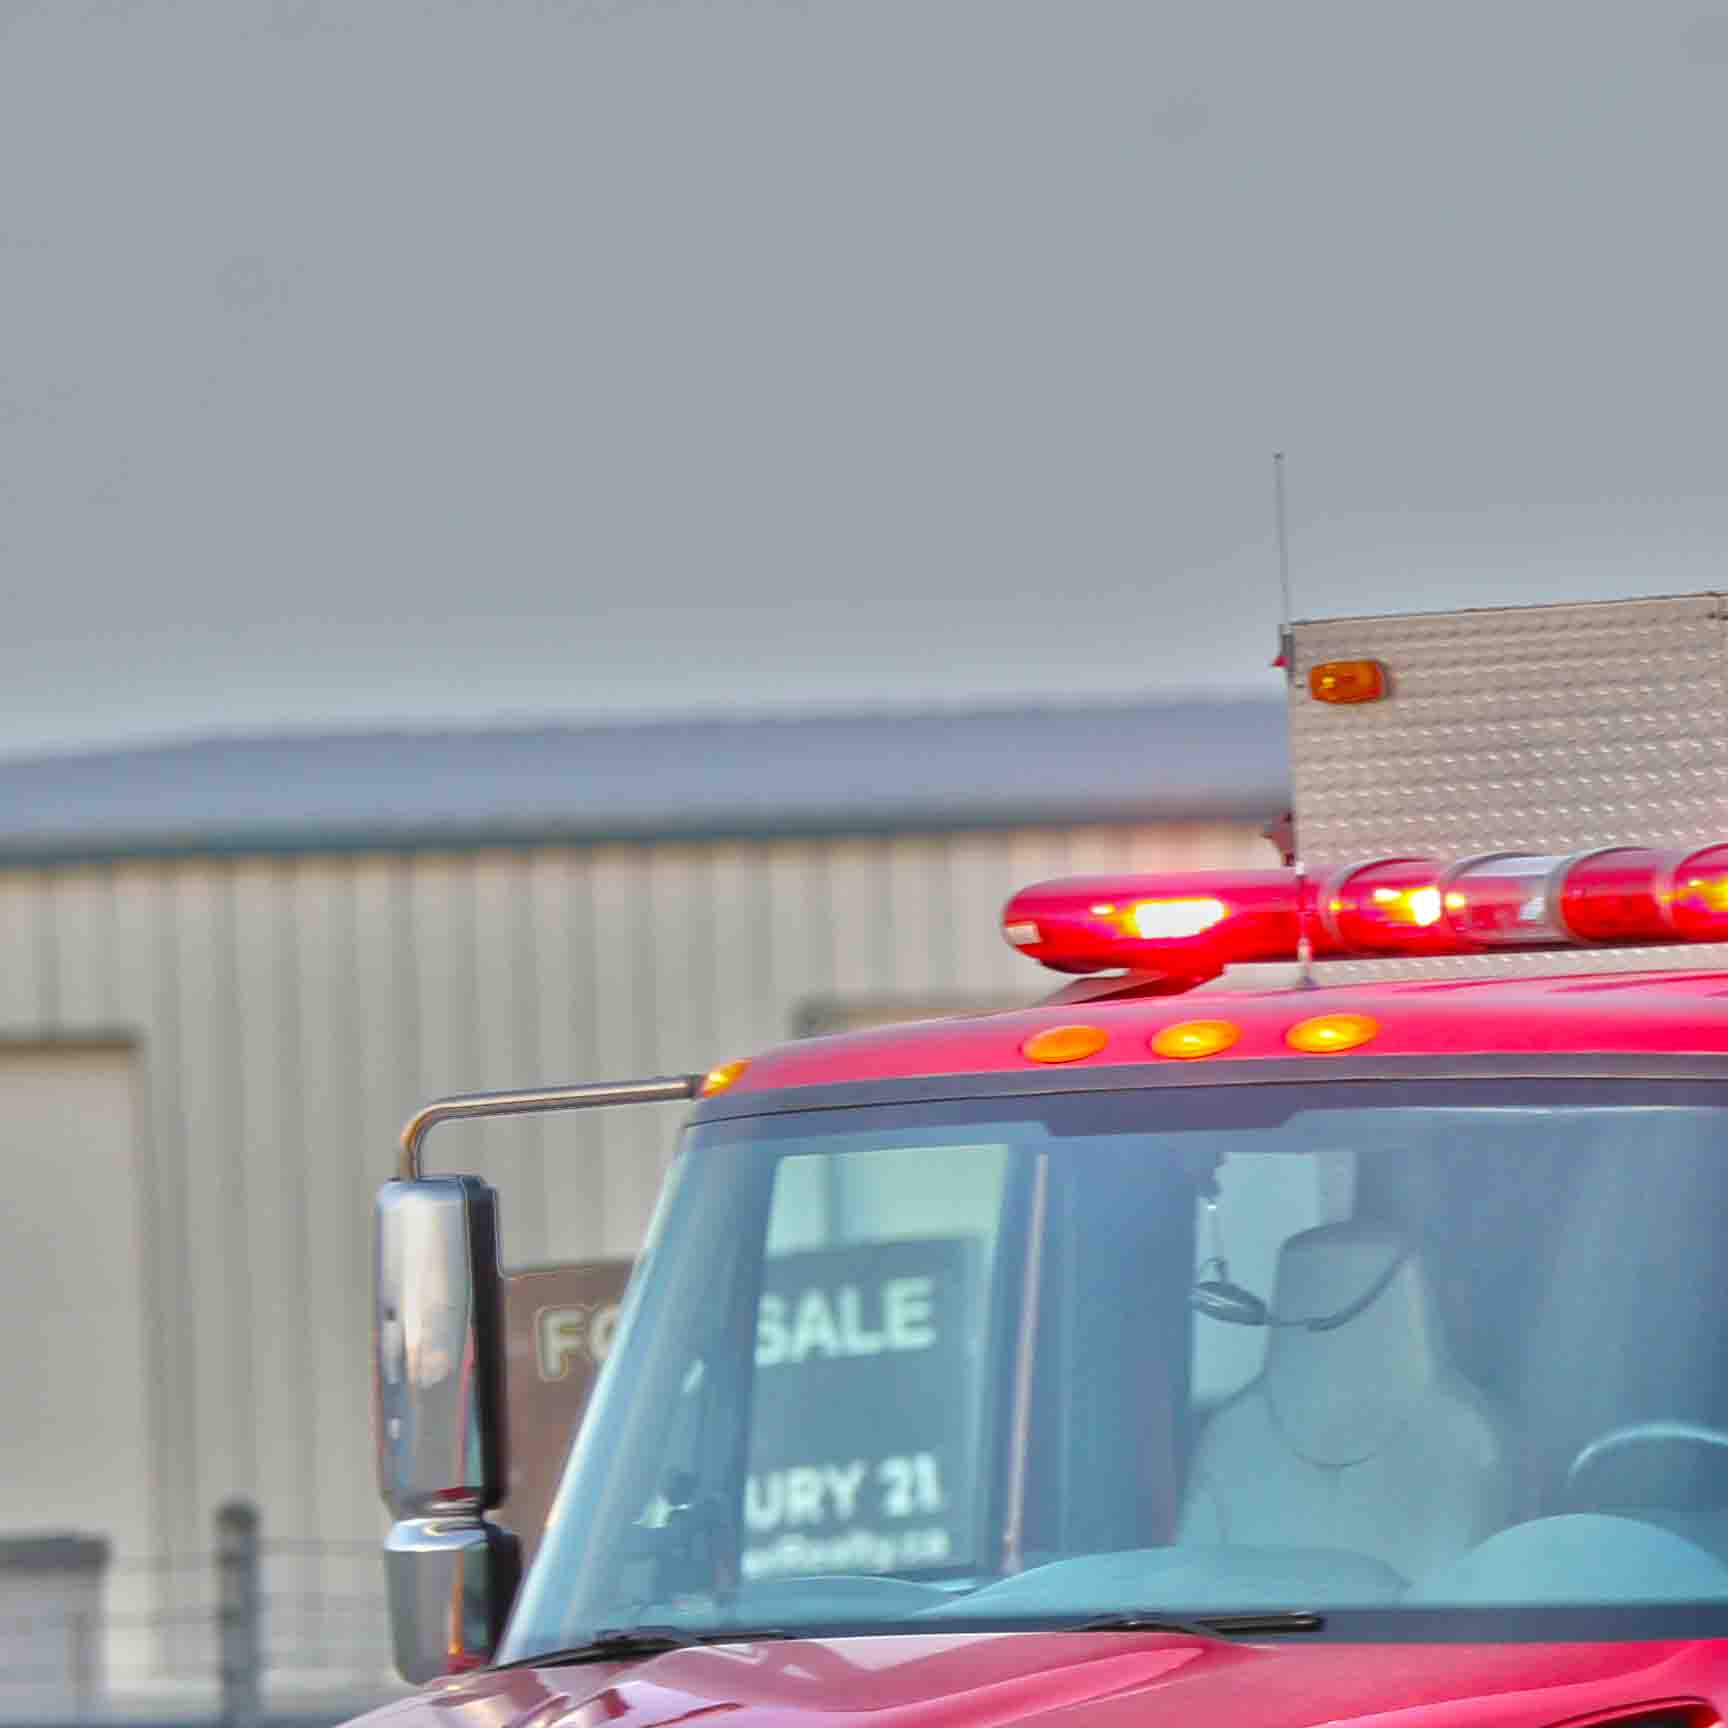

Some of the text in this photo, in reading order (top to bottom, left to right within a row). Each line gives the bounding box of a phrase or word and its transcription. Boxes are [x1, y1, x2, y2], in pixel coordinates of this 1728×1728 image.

[538, 1276, 937, 1380] FO SALE
[879, 1450, 944, 1519] 21
